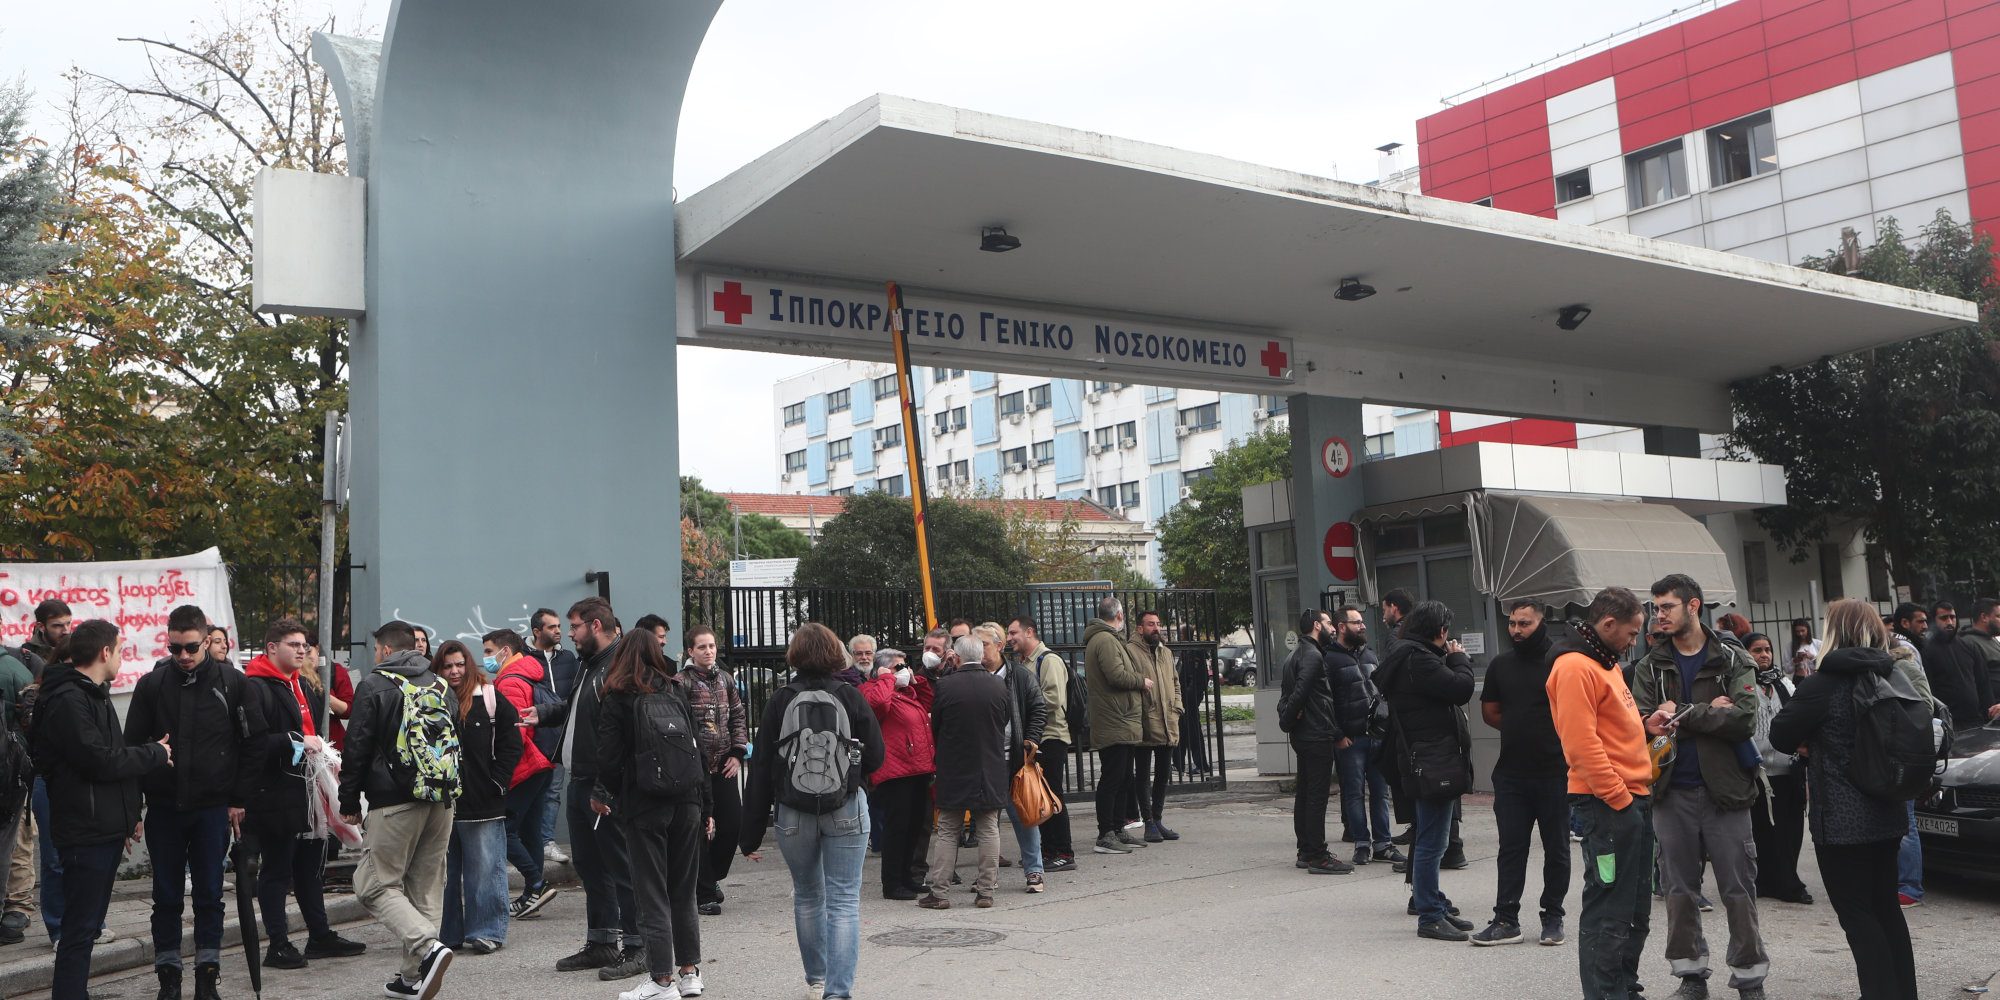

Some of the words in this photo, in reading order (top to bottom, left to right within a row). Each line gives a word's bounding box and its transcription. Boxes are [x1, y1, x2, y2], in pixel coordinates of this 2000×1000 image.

[980, 311, 1074, 351] ΓΕΝΙΚΟ
[1094, 323, 1247, 368] ΝΟΣΟΚΟΜΕΙΟ
[1331, 449, 1337, 465] 4
[117, 570, 195, 607] μοιράζει
